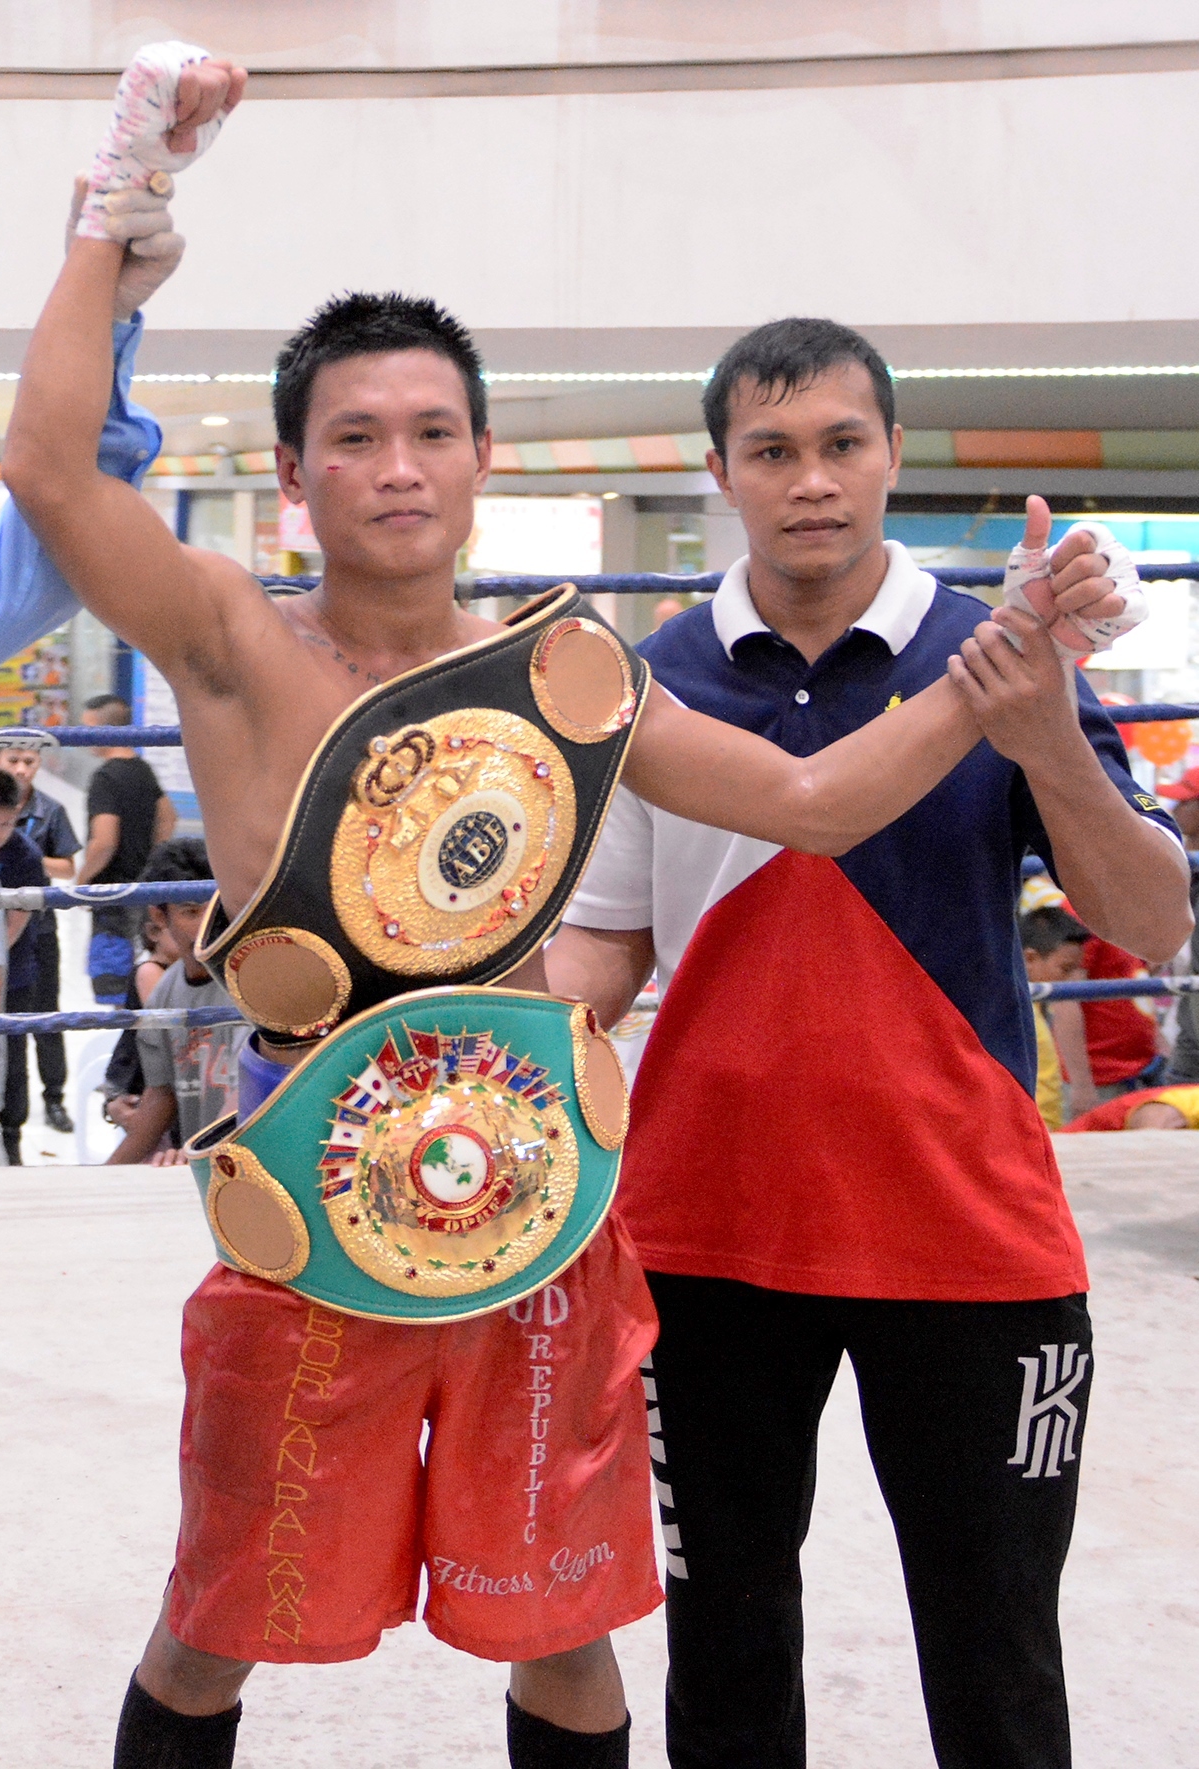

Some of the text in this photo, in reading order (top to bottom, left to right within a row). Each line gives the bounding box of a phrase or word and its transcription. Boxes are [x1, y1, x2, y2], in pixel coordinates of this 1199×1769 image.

[452, 816, 506, 886] ABF
[508, 1284, 570, 1327] OD
[523, 1333, 554, 1545] REPUBLIC
[263, 1481, 309, 1645] PALAWAN
[432, 1541, 615, 1598] Fitness Gym
